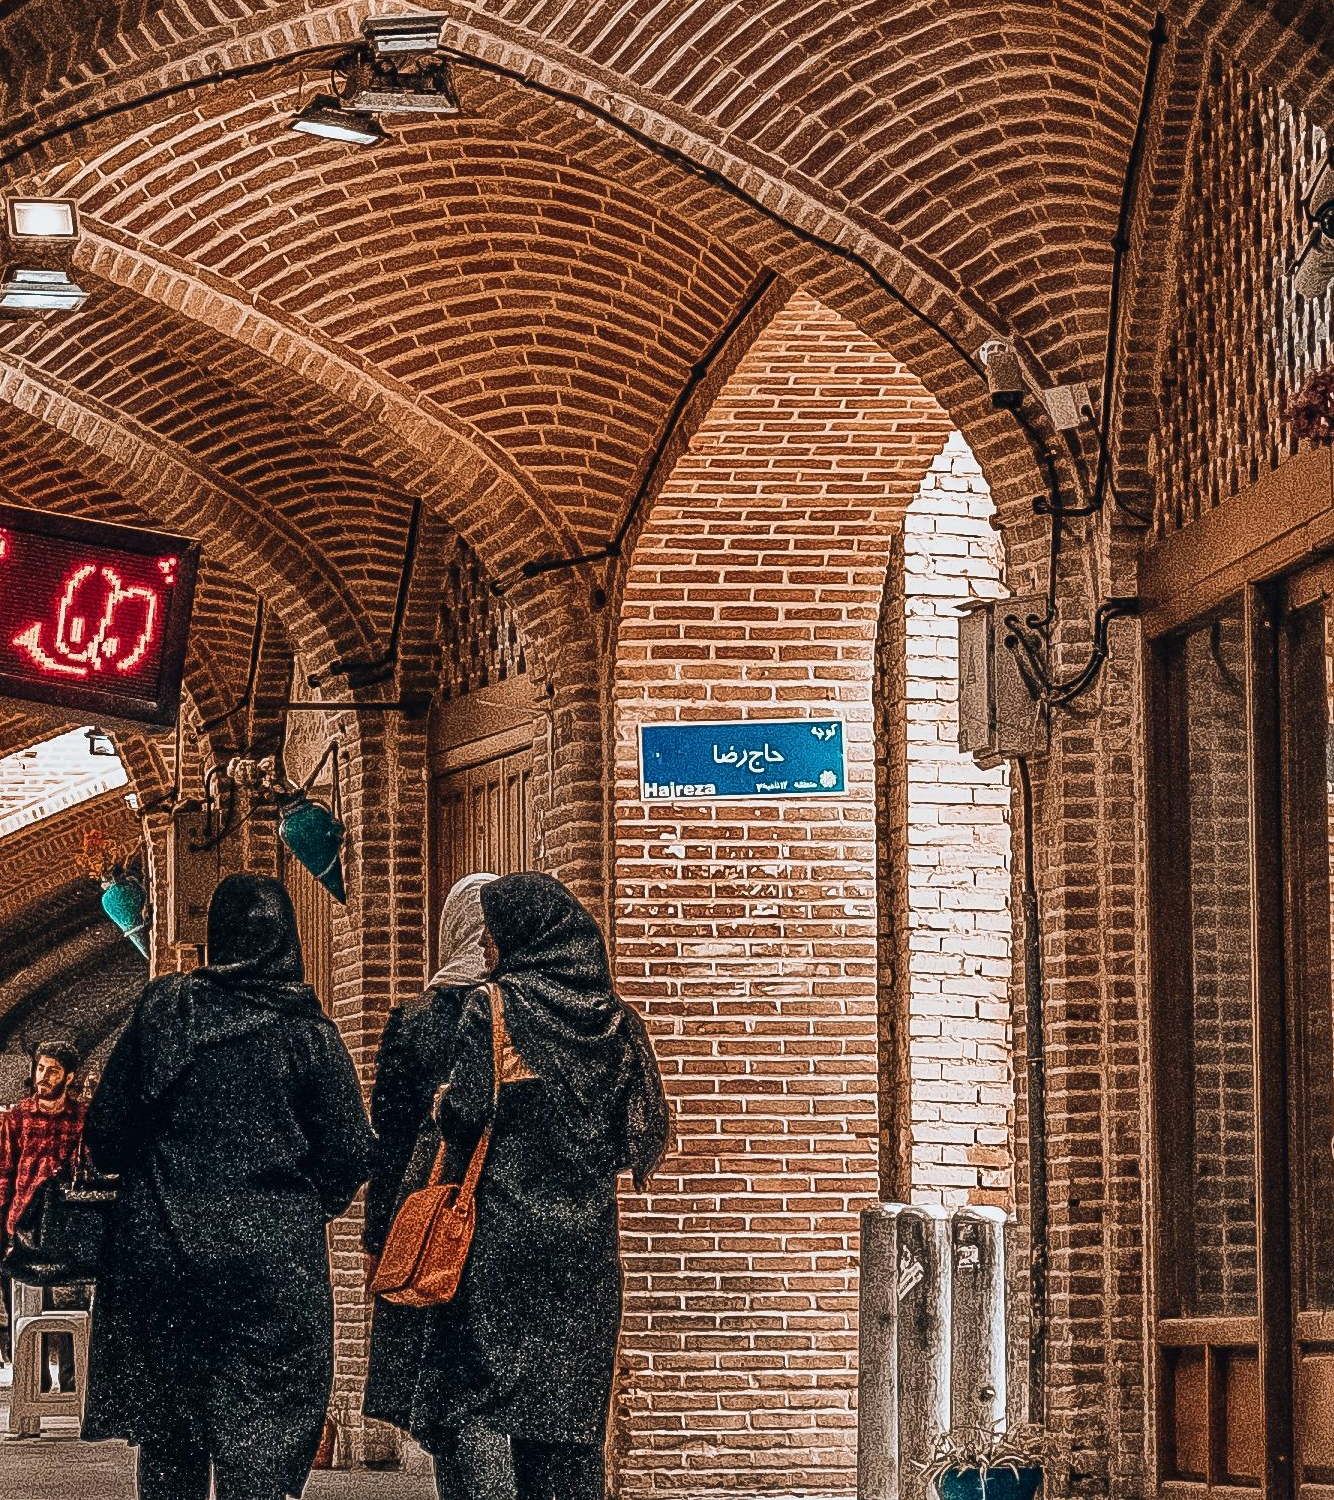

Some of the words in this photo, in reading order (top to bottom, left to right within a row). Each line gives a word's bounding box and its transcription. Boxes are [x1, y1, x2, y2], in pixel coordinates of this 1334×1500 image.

[811, 723, 838, 741] کوچه
[713, 744, 748, 768] رضا
[749, 743, 785, 773] حاج
